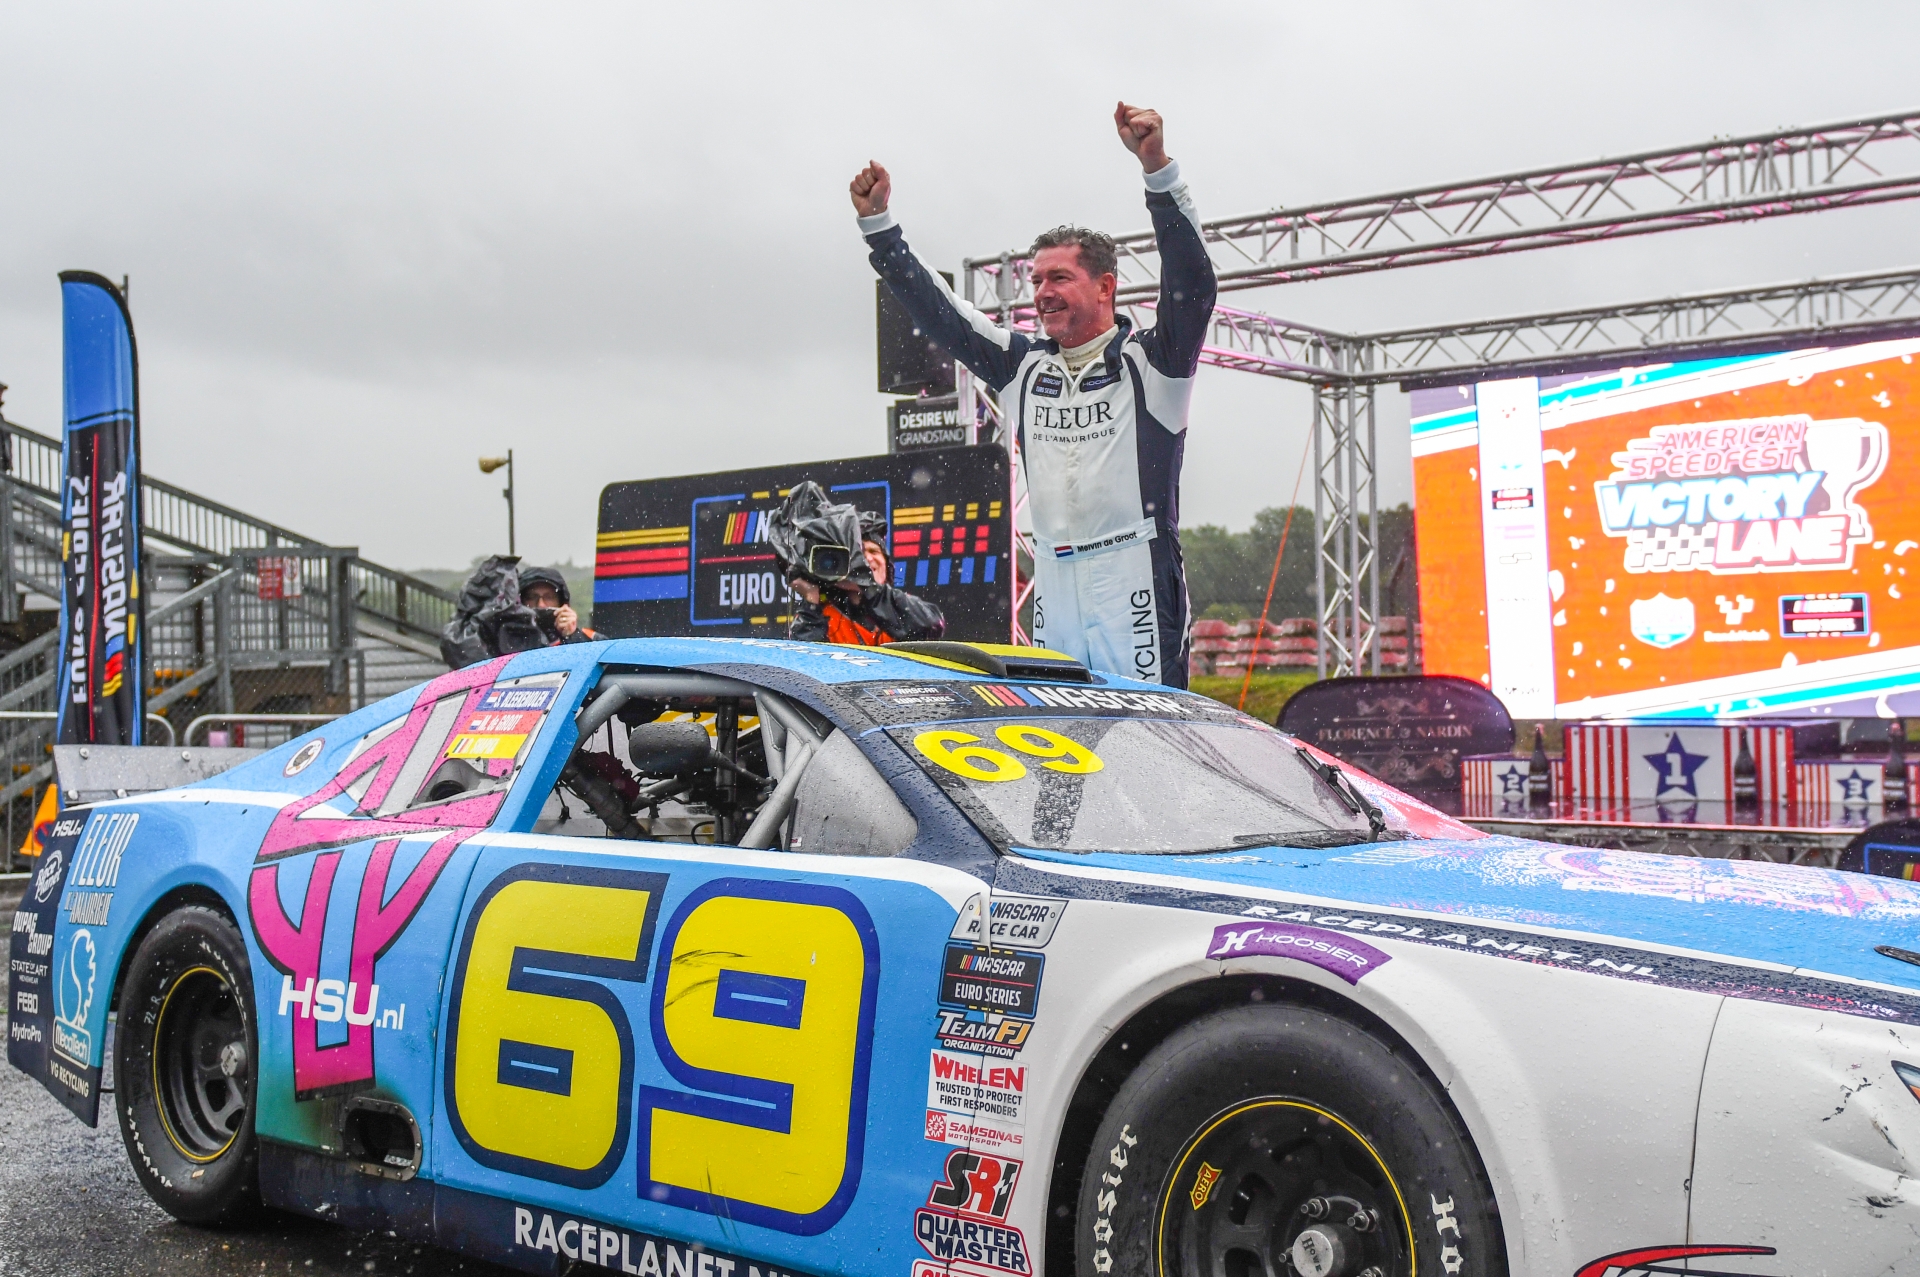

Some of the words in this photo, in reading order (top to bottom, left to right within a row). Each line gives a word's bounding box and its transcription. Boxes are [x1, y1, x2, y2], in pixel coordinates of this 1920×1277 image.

[900, 412, 942, 429] DESIRE
[1033, 401, 1114, 429] FLEUR
[900, 428, 965, 446] GRANDSTAND
[1659, 421, 1805, 451] AMERICAN
[1628, 446, 1801, 478] SPEEDFEST
[1599, 470, 1826, 530] VICTORY
[1077, 541, 1102, 553] Melvin
[1103, 539, 1113, 547] de
[1115, 531, 1138, 543] Groot
[1713, 515, 1850, 567] LANE
[719, 571, 775, 606] EURO
[1028, 687, 1193, 714] NASCAR
[1318, 726, 1396, 741] FLORENCE
[1416, 724, 1473, 739] NARDIN
[913, 725, 1104, 782] 69
[1665, 752, 1688, 785] 1
[1507, 775, 1520, 789] 2
[1848, 779, 1862, 794] 3
[70, 813, 140, 887] FLEUR
[12, 910, 38, 934] DUPAG
[991, 902, 1050, 923] NASCAR
[1009, 925, 1040, 940] CAR
[27, 934, 53, 957] GROUP
[1255, 934, 1369, 969] HOOSIER
[974, 956, 1026, 978] NASCAR
[278, 974, 406, 1031] HSU.nl
[954, 982, 983, 1001] EURO
[984, 986, 1022, 1007] SERIES
[11, 1021, 42, 1043] HydroPro
[444, 862, 881, 1236] 69
[943, 1038, 1015, 1058] ORGANIZATION
[50, 1060, 59, 1078] VG
[59, 1065, 89, 1098] RECYCLING
[935, 1081, 971, 1097] TRUSTED
[973, 1087, 984, 1099] TO
[986, 1090, 1022, 1106] PROTECT
[939, 1094, 962, 1109] FIRST
[963, 1098, 1018, 1118] RESPONDERS
[947, 1132, 1002, 1148] MOTORSPORT
[948, 1121, 1023, 1145] SAMSONAS
[1194, 1168, 1213, 1202] AERO
[917, 1212, 1021, 1251] QUARTER
[935, 1236, 1026, 1272] MASTER
